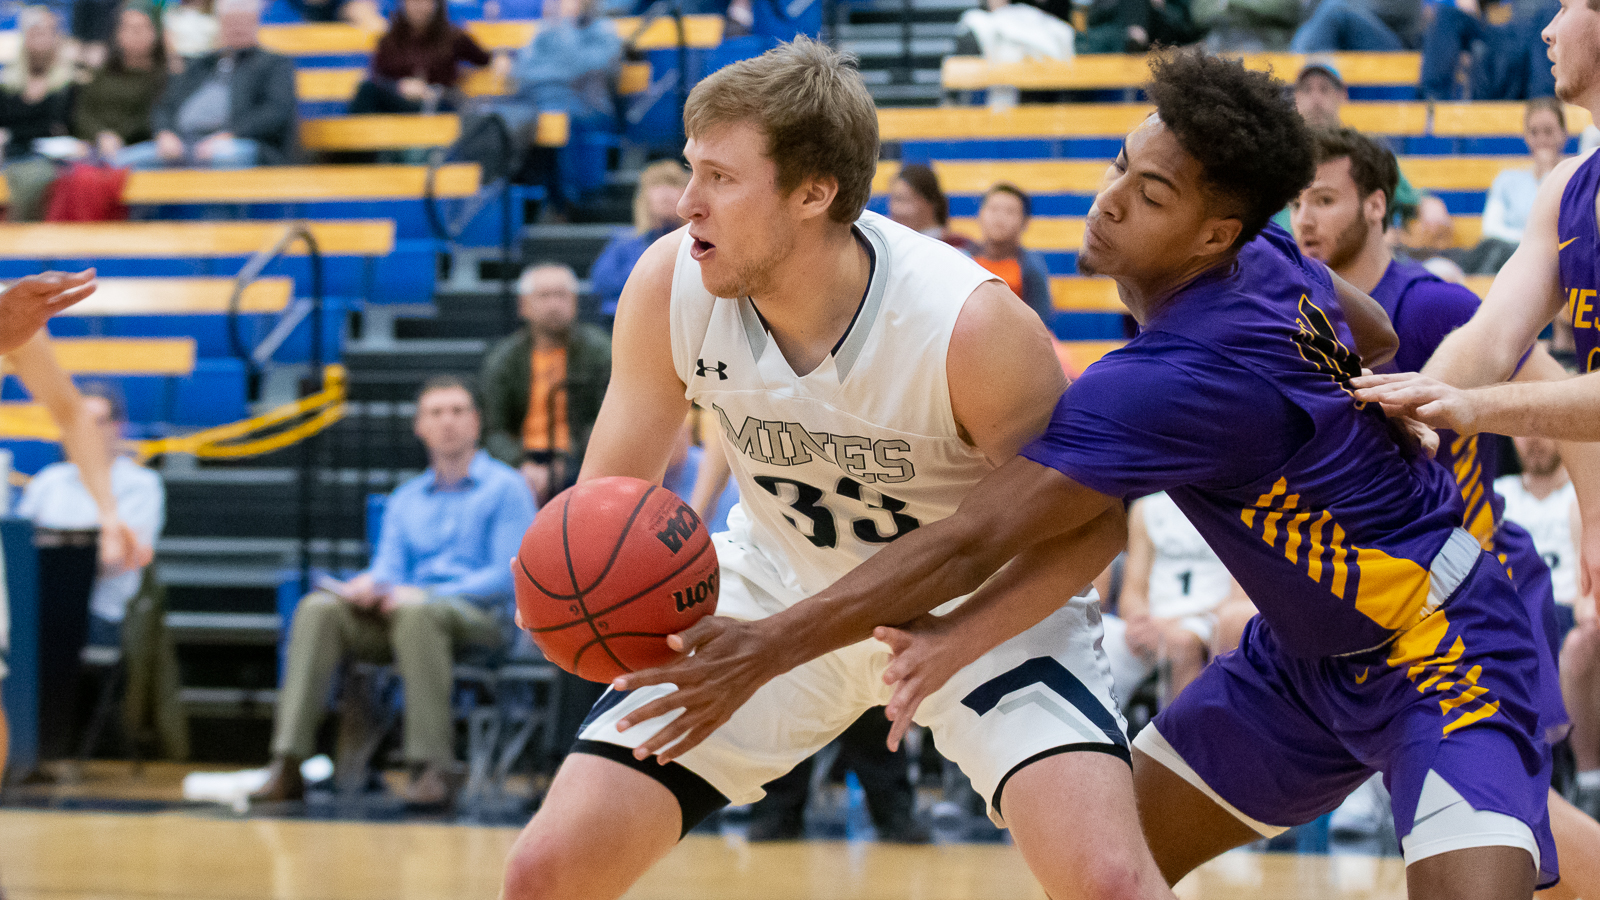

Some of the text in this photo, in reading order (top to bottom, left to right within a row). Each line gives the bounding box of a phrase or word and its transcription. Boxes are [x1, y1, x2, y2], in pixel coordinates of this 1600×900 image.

[712, 402, 916, 484] MINES
[656, 501, 701, 555] CAA
[752, 474, 921, 549] 33
[673, 567, 719, 613] son
[1176, 569, 1193, 596] 1
